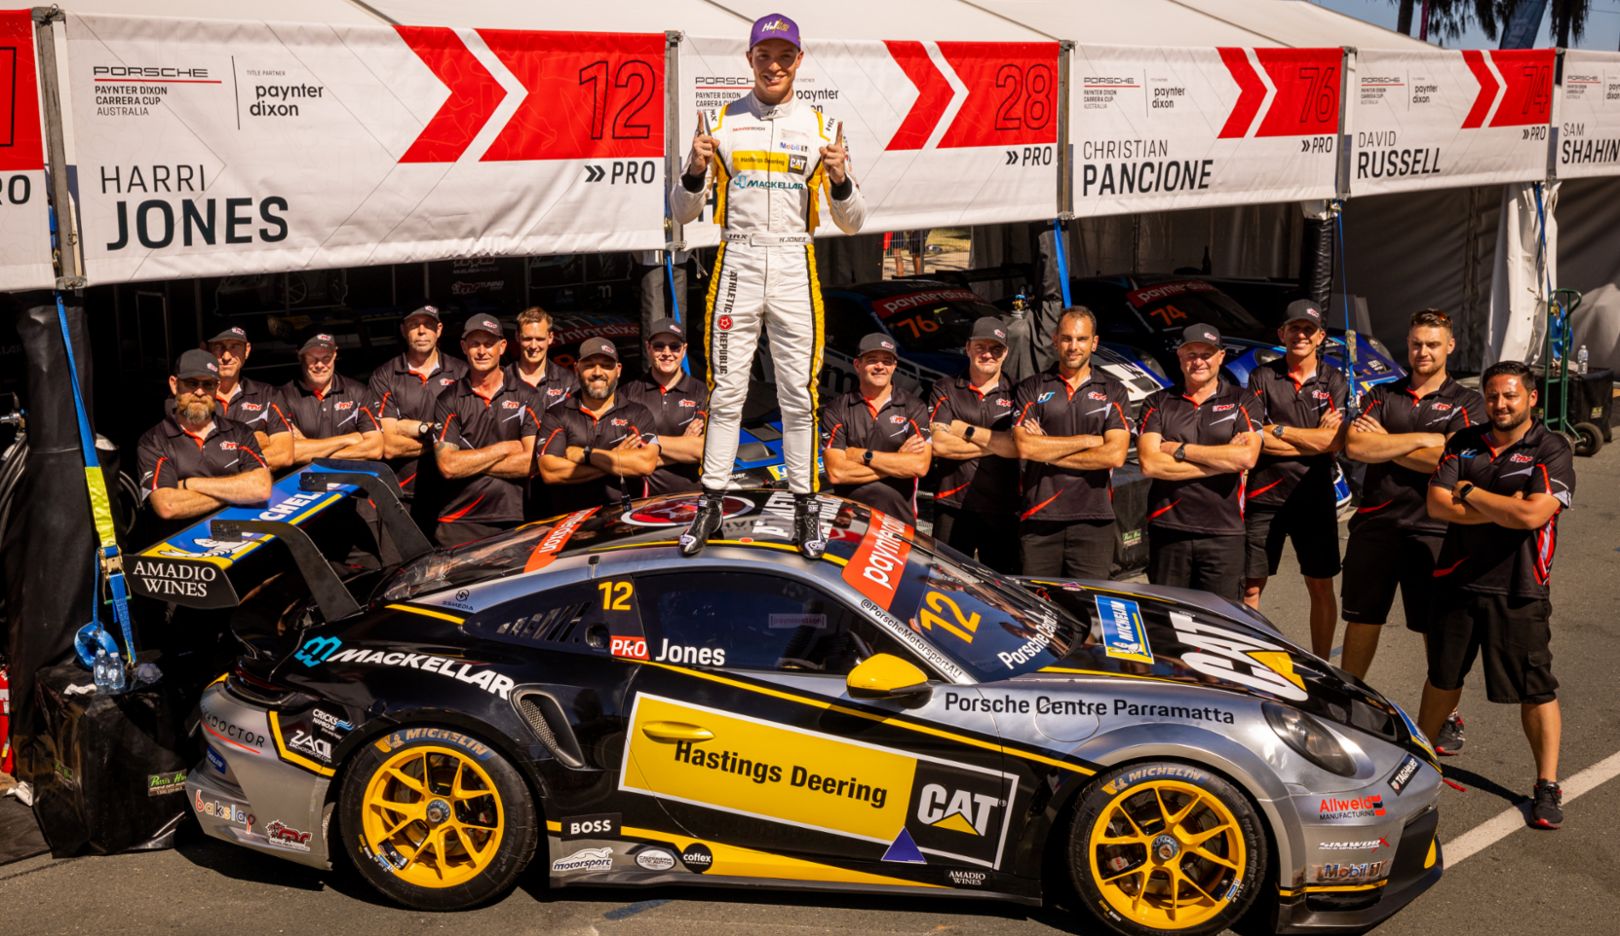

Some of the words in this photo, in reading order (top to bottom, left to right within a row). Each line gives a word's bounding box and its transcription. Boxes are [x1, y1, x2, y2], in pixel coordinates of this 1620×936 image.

[93, 66, 209, 78] PORSCHE
[696, 77, 755, 85] PORSCH
[95, 85, 138, 95] PAYNTER
[139, 86, 168, 95] DIXON
[96, 96, 140, 105] CARRERA
[142, 96, 161, 105] CUP
[255, 83, 324, 101] paynter
[579, 60, 655, 140] 12
[994, 63, 1053, 131] 28
[1154, 86, 1185, 97] paynter
[1300, 67, 1335, 124] 76
[1522, 65, 1550, 115] 74
[97, 107, 149, 116] AUSTRALIA
[249, 101, 299, 117] dixon
[1152, 98, 1174, 108] dixon
[1358, 130, 1397, 148] DAVID
[1530, 126, 1546, 141] PRO
[1563, 122, 1585, 137] SAM
[1083, 140, 1168, 160] CHRISTIAN
[1312, 136, 1333, 154] PRO
[1561, 139, 1620, 164] SHAHIN
[1022, 146, 1052, 167] PRO
[1357, 147, 1441, 179] RUSSELL
[100, 164, 206, 194] HARRI
[611, 161, 655, 184] PRO
[1083, 159, 1213, 196] PANCIONE
[747, 180, 804, 190] MACKELLAR
[107, 195, 289, 251] JONES
[723, 270, 738, 313] ATHLETIC
[1150, 304, 1187, 326] 74
[895, 314, 939, 338] 76
[719, 332, 729, 375] REPUBLIC
[132, 560, 217, 582] AMADIO
[141, 577, 208, 598] WINES
[597, 579, 634, 611] 12
[919, 590, 982, 644] 12
[1110, 600, 1134, 642] MICHELIN
[610, 638, 647, 657] PRO
[861, 598, 963, 678] @PorscheMotorsportAU
[655, 637, 726, 666] Jones
[997, 633, 1051, 670] Porsche
[1169, 611, 1309, 701] CAT
[326, 648, 516, 701] MACKELLAR
[312, 708, 339, 726] CRICKS
[945, 692, 1030, 714] Porsche
[1036, 696, 1107, 716] Centre
[1113, 699, 1235, 725] Parramatta
[406, 727, 488, 756] MICHELIN
[674, 740, 782, 785] Hastings
[790, 765, 888, 809] Deering
[1129, 766, 1202, 782] MICHELIN
[917, 783, 999, 837] CAT
[1319, 795, 1373, 813] Allweld
[1319, 808, 1376, 821] MANUFACTURING
[570, 819, 612, 835] BOSS
[553, 858, 612, 871] motorsport
[683, 853, 712, 863] coffex
[949, 870, 986, 881] AMADIO
[1323, 862, 1367, 879] Mobil
[953, 877, 982, 886] WINES
